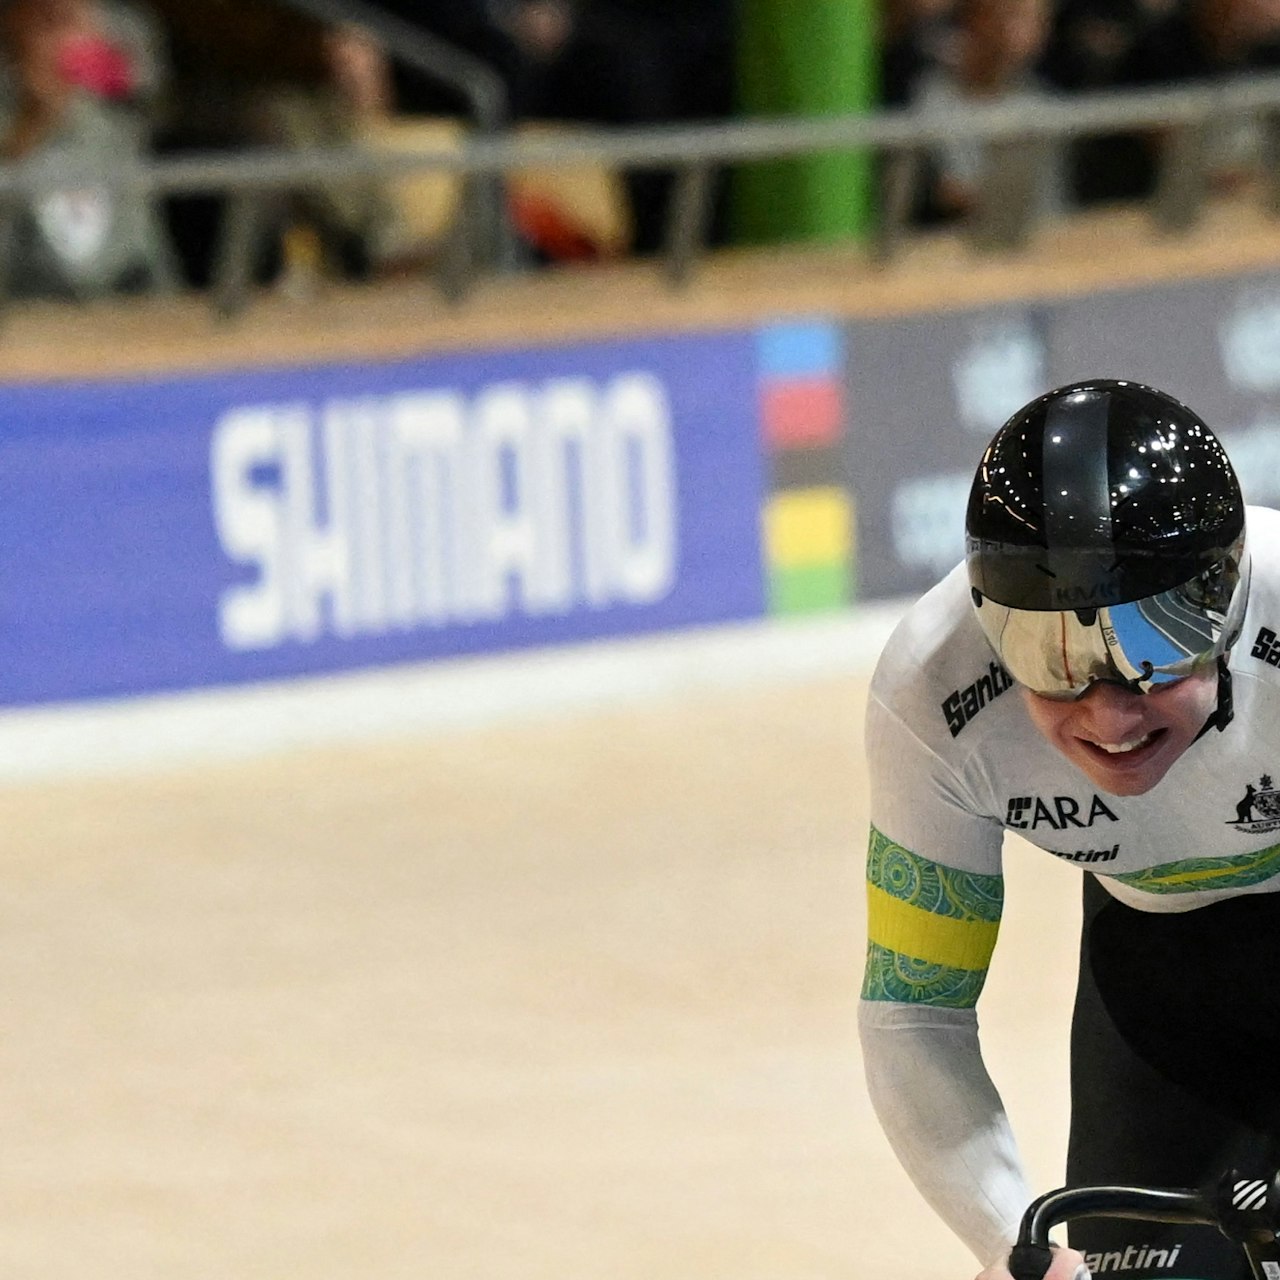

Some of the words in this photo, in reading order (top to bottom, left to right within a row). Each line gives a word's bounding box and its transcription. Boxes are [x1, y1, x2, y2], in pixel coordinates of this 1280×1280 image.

[211, 371, 678, 650] SHIMANO
[941, 661, 1014, 738] Santi
[1049, 845, 1119, 862] ntini
